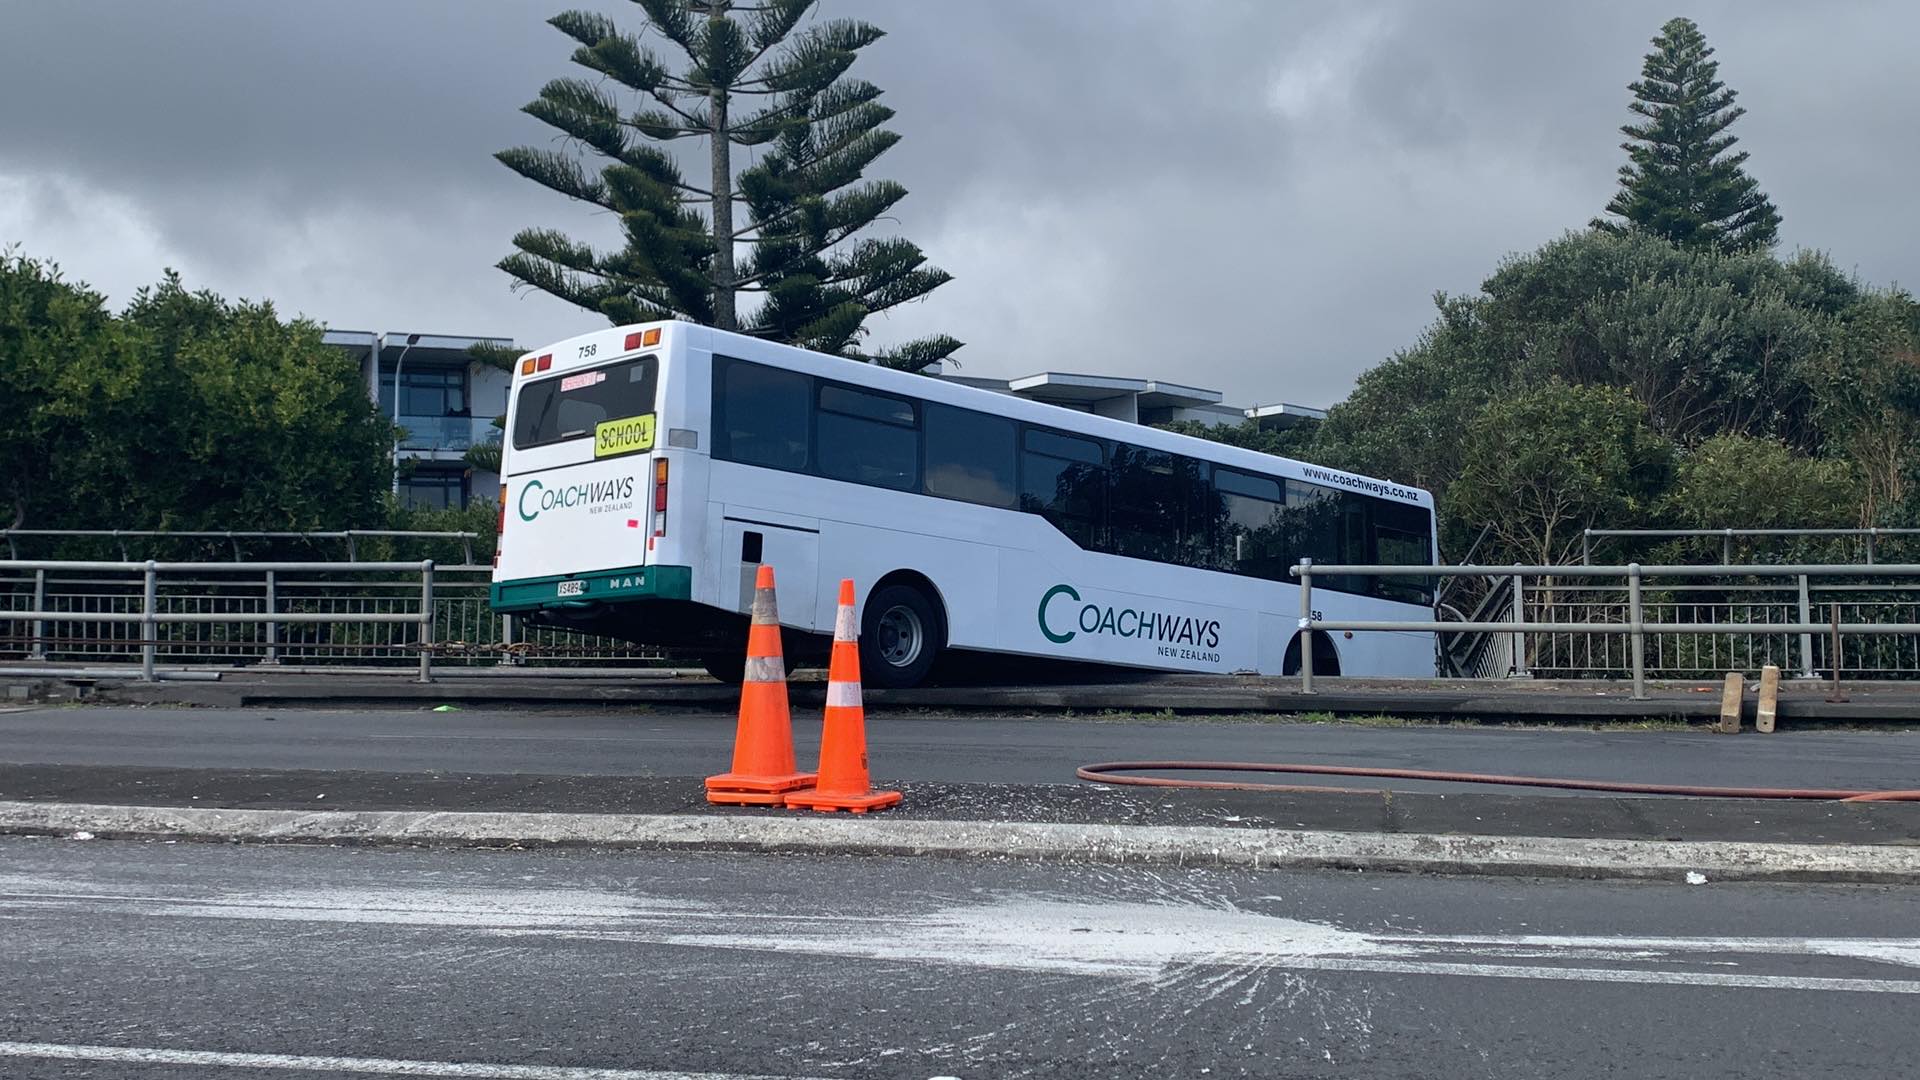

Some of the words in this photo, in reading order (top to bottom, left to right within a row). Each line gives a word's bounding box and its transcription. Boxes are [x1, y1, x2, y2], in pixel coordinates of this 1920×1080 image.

[578, 344, 597, 359] 758
[600, 422, 649, 450] SCHOOL
[1303, 467, 1418, 501] www.coachways.co.nz
[519, 476, 634, 522] COACHWAYS
[589, 506, 603, 515] NEW
[604, 501, 633, 513] ZEALAND
[610, 576, 645, 589] MAN
[1038, 584, 1221, 649] COACHWAYS
[1310, 610, 1323, 622] 58
[1158, 646, 1178, 658] NEW
[1180, 649, 1221, 663] ZEALAND
